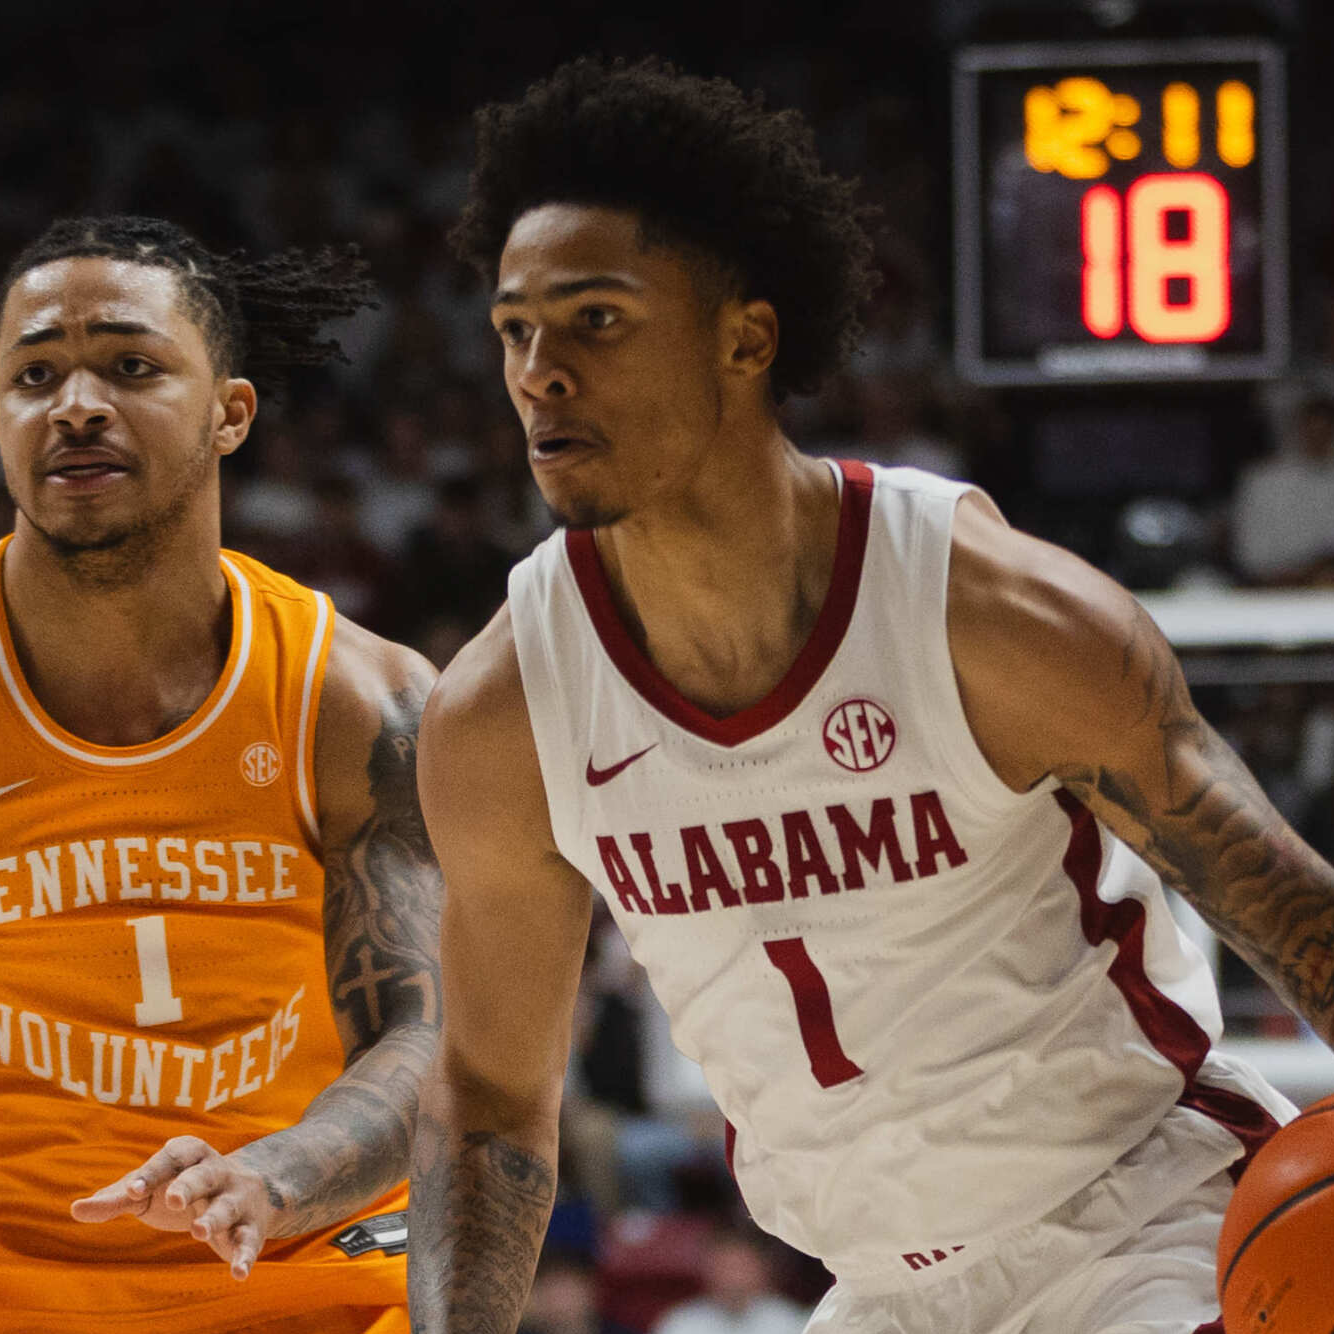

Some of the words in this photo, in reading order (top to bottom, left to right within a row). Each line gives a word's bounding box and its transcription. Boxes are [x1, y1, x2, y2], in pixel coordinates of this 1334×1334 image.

[1024, 77, 1255, 179] 12:11
[1081, 172, 1231, 344] 18
[241, 743, 281, 786] SEC
[824, 700, 895, 773] SEC
[595, 789, 969, 917] ALABAMA
[126, 914, 183, 1027] 1
[762, 937, 866, 1089] 1
